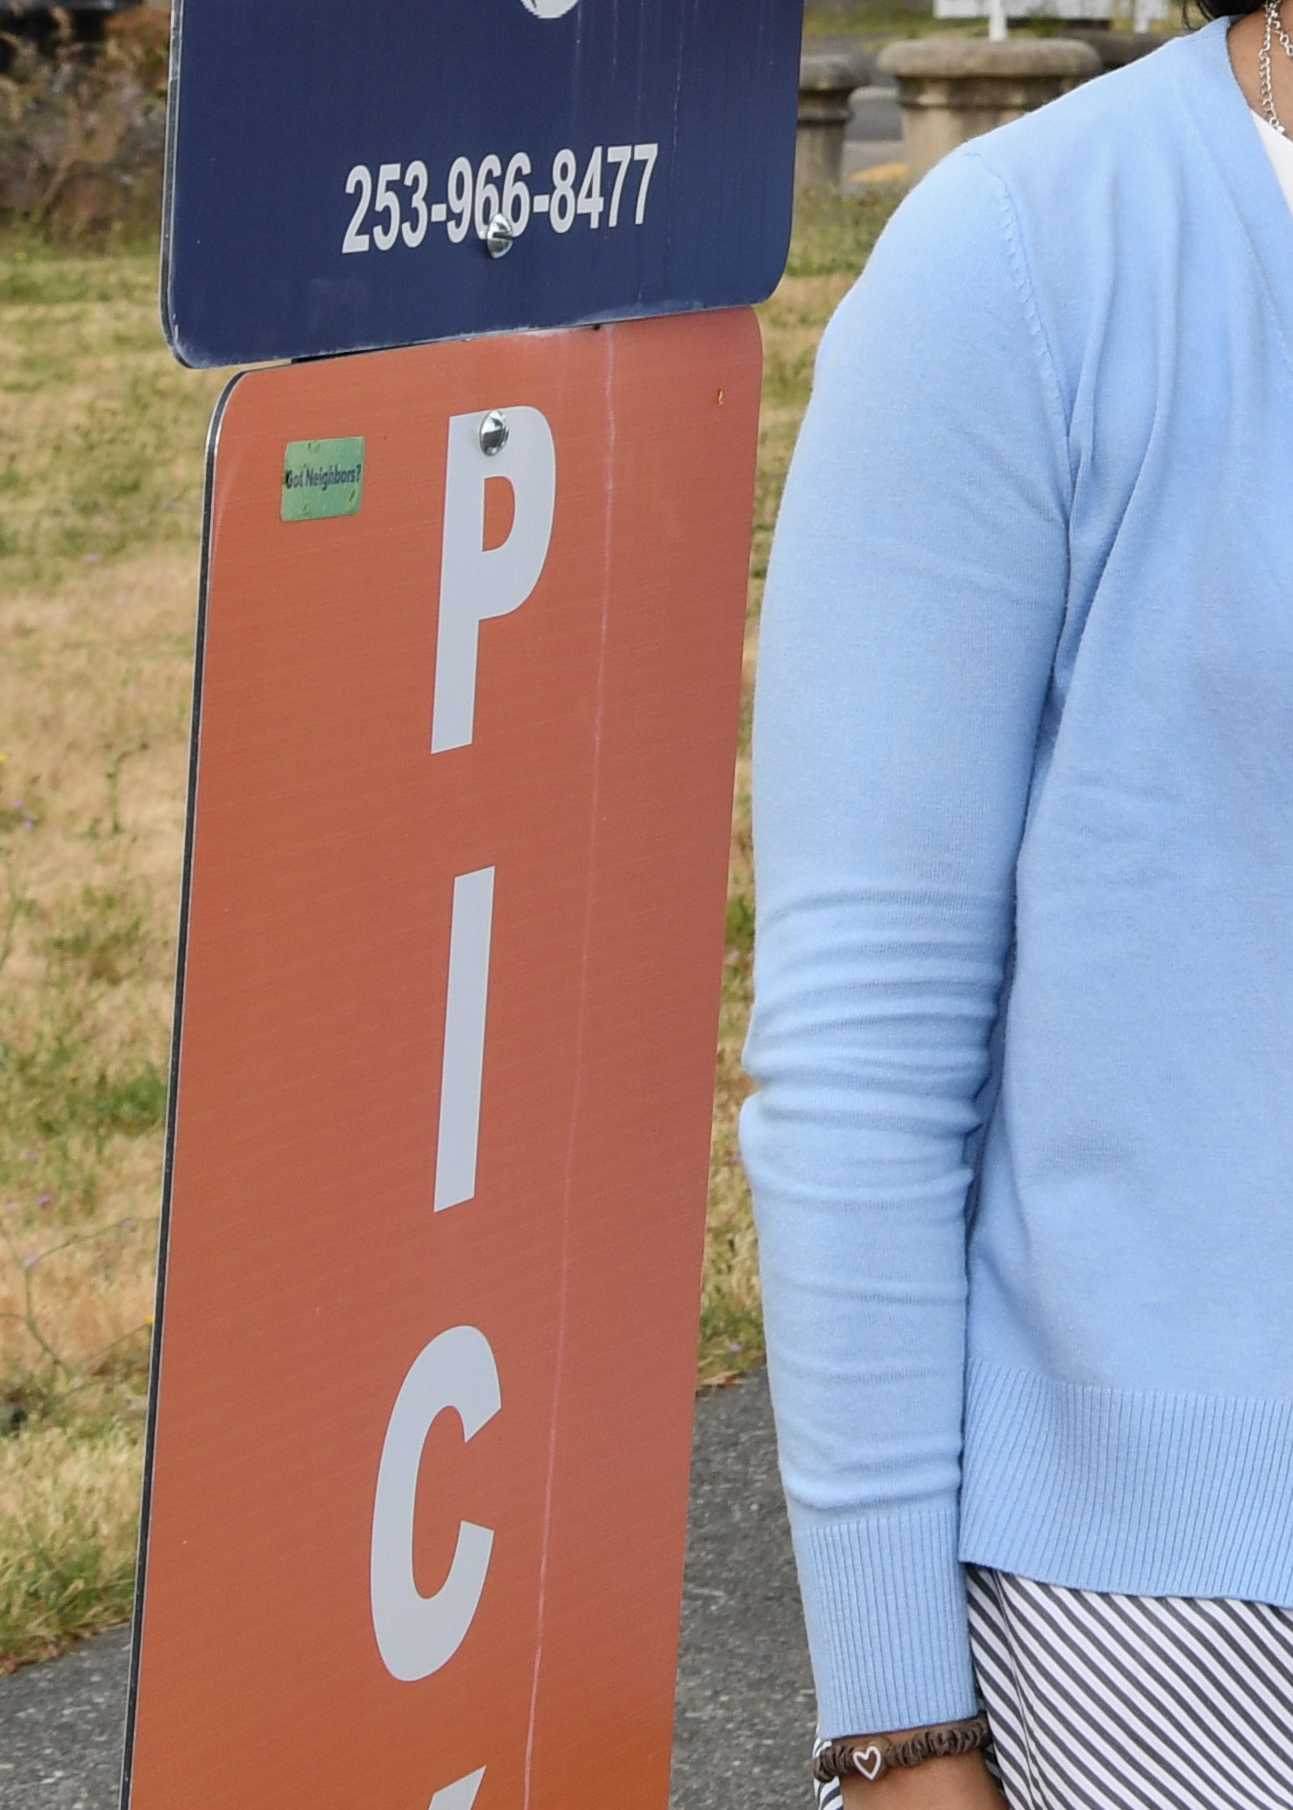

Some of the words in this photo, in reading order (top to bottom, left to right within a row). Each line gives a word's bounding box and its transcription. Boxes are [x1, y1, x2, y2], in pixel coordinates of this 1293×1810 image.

[341, 143, 659, 255] 253-966-8477
[286, 466, 305, 489] Got
[305, 463, 362, 491] Neighbors?
[370, 405, 557, 1810] PIC
